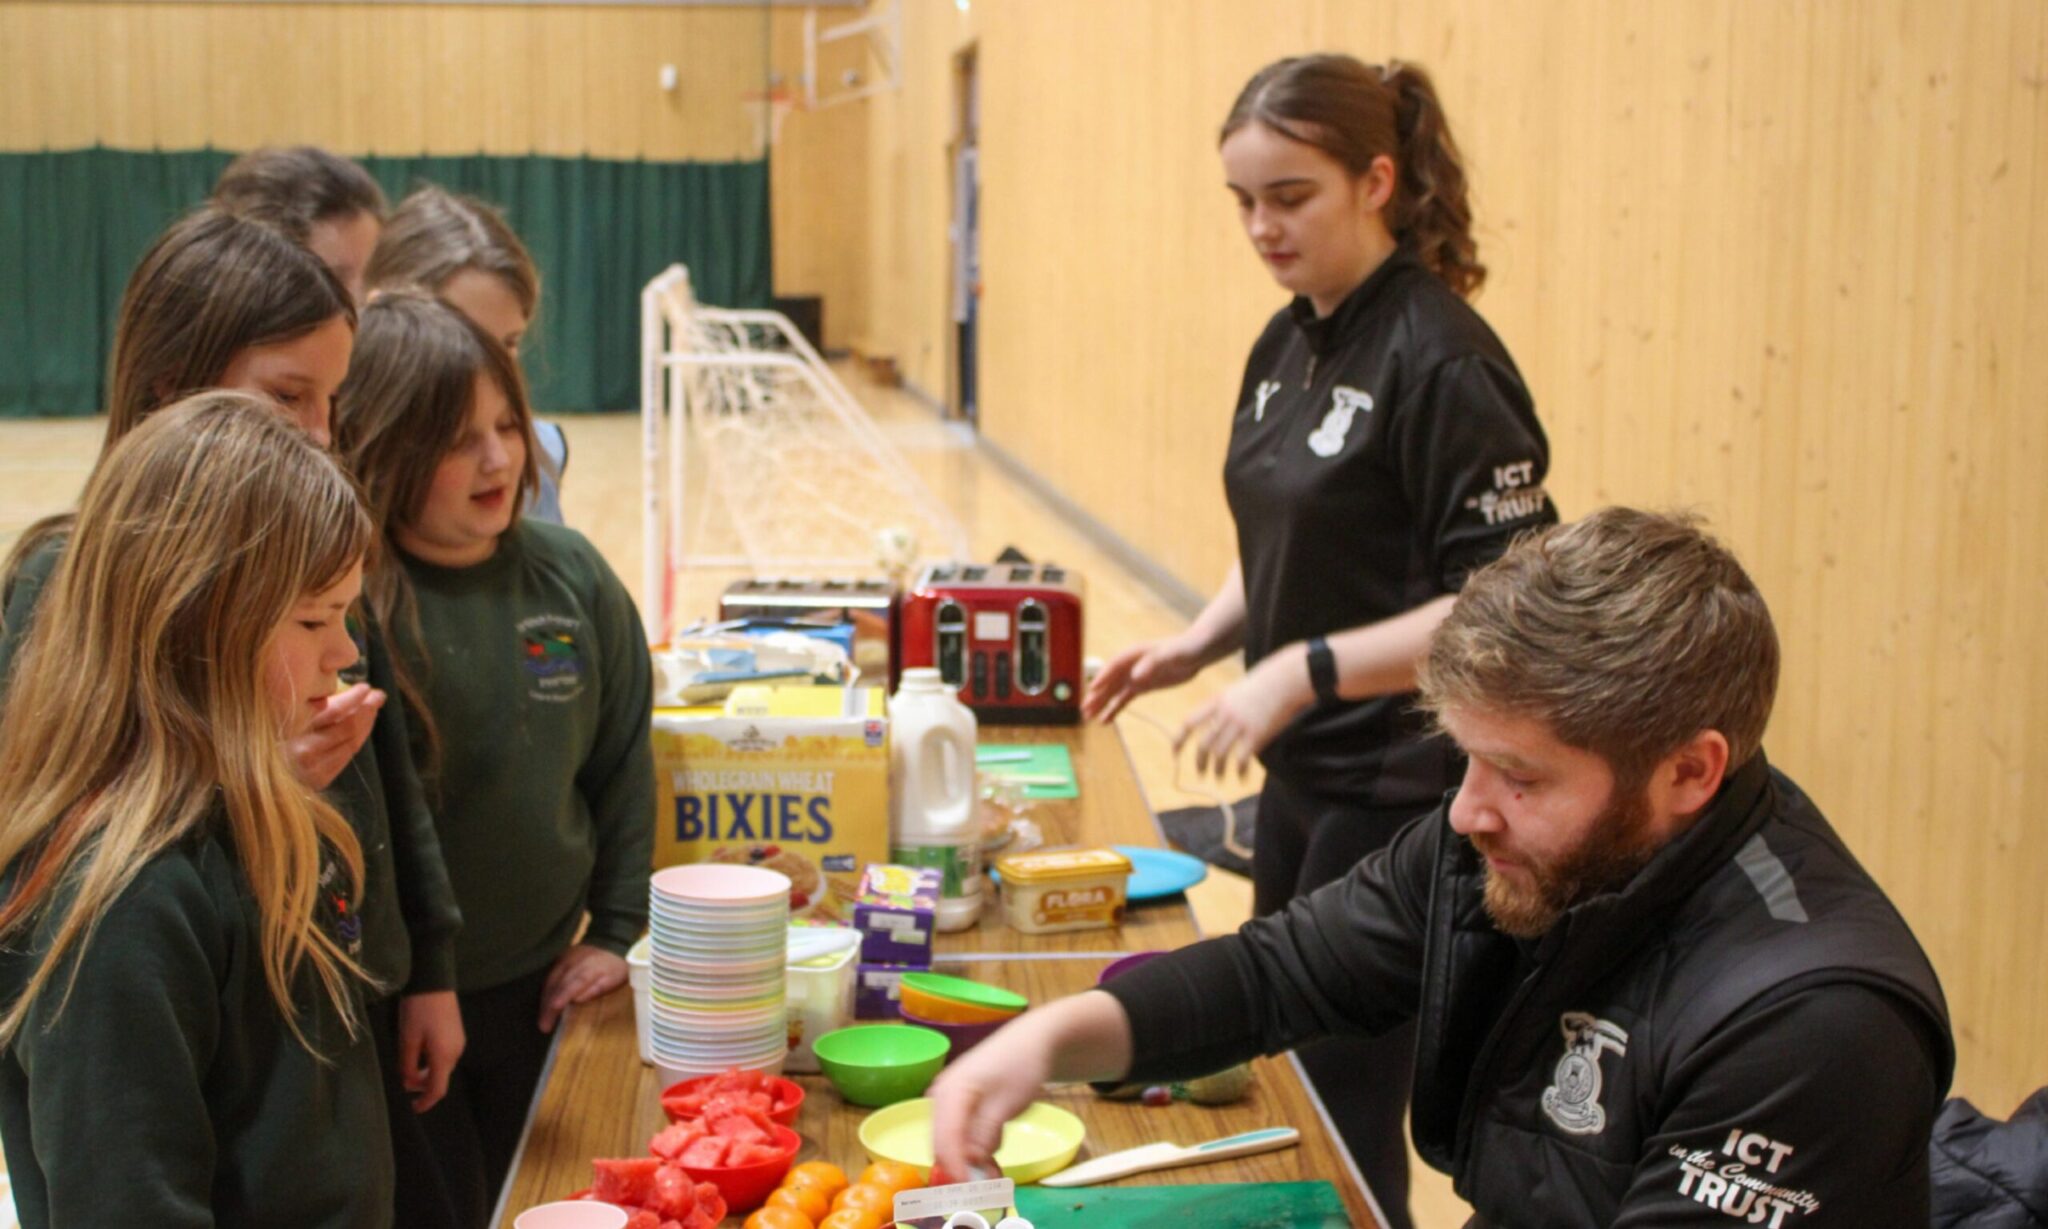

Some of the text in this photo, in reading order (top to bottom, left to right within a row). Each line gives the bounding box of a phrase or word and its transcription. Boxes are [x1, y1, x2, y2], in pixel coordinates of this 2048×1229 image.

[1493, 460, 1533, 489] ICT
[672, 770, 835, 794] WHOLEGRAIN WHEAT
[674, 793, 833, 843] BIXIES
[1047, 888, 1105, 909] FLORA
[1722, 1128, 1794, 1173] ICT
[1668, 1143, 1820, 1215] in the Community
[1678, 1162, 1795, 1229] TRUST
